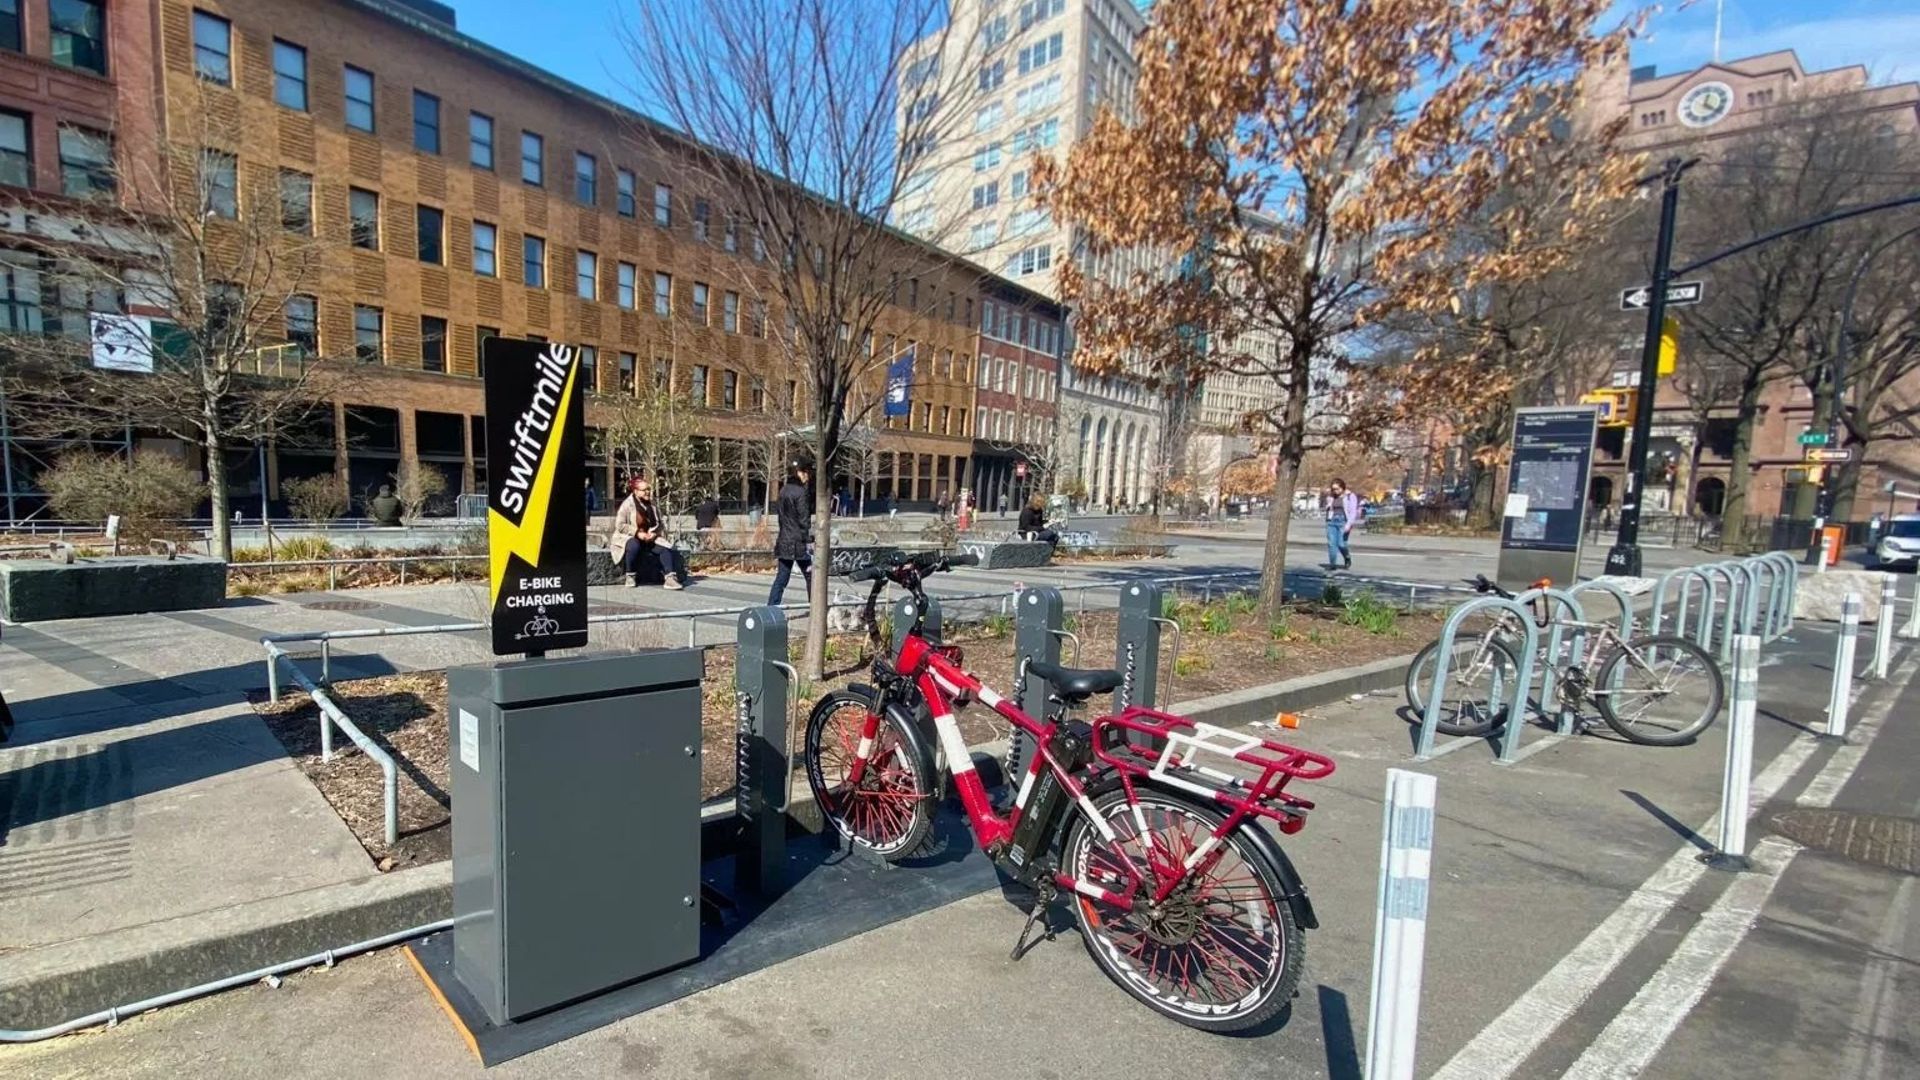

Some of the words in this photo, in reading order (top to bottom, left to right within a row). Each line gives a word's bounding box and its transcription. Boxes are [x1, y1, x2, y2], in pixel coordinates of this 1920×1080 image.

[500, 342, 572, 514] swiftmile
[505, 593, 575, 608] CHARGING
[519, 576, 562, 590] E-BIKE
[1096, 933, 1262, 1015] EASTON
